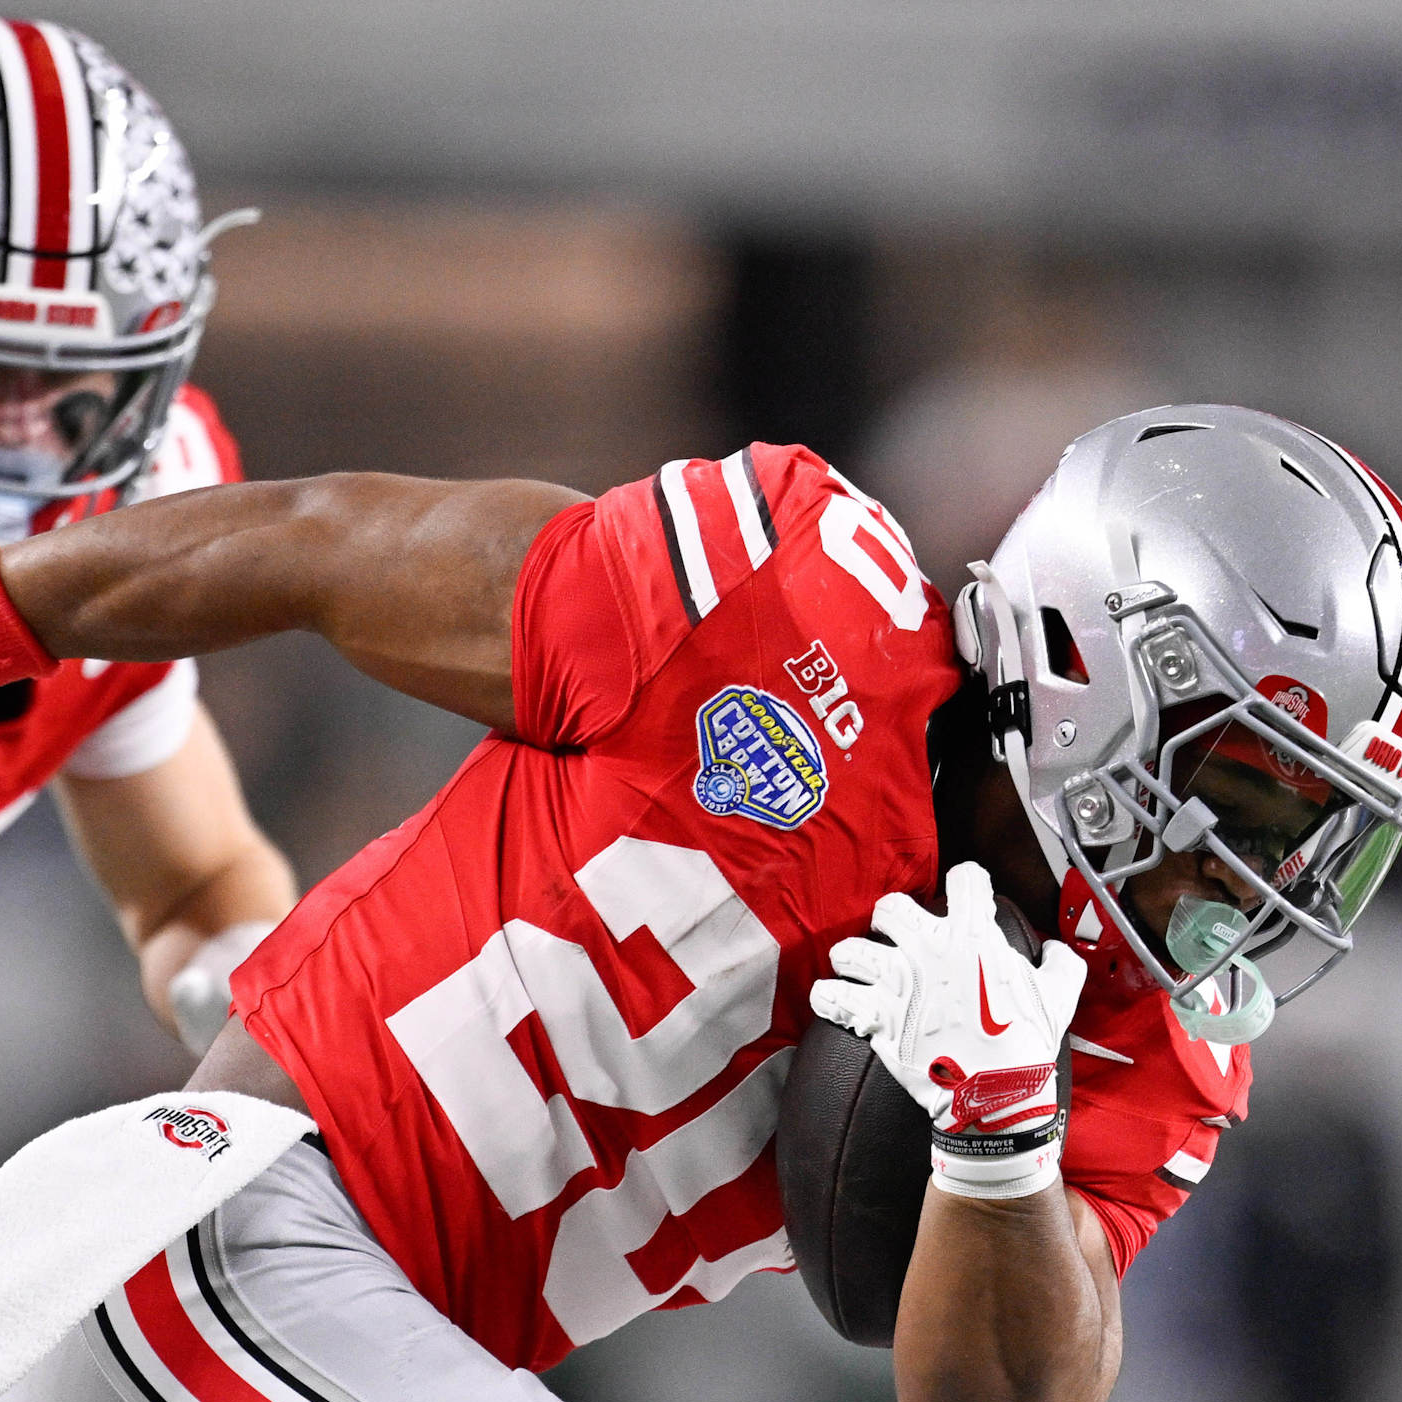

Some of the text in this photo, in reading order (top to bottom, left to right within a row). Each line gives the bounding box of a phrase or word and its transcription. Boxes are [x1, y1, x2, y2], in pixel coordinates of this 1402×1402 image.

[711, 701, 813, 815] COTTON
[717, 733, 775, 804] BOWL
[710, 763, 745, 804] CLASSIC
[703, 799, 728, 813] 1937
[385, 837, 797, 1348] 20
[946, 1144, 984, 1155] REQUESTS
[985, 1147, 996, 1155] TO
[971, 1140, 982, 1148] BY
[984, 1139, 1014, 1148] PRAYER
